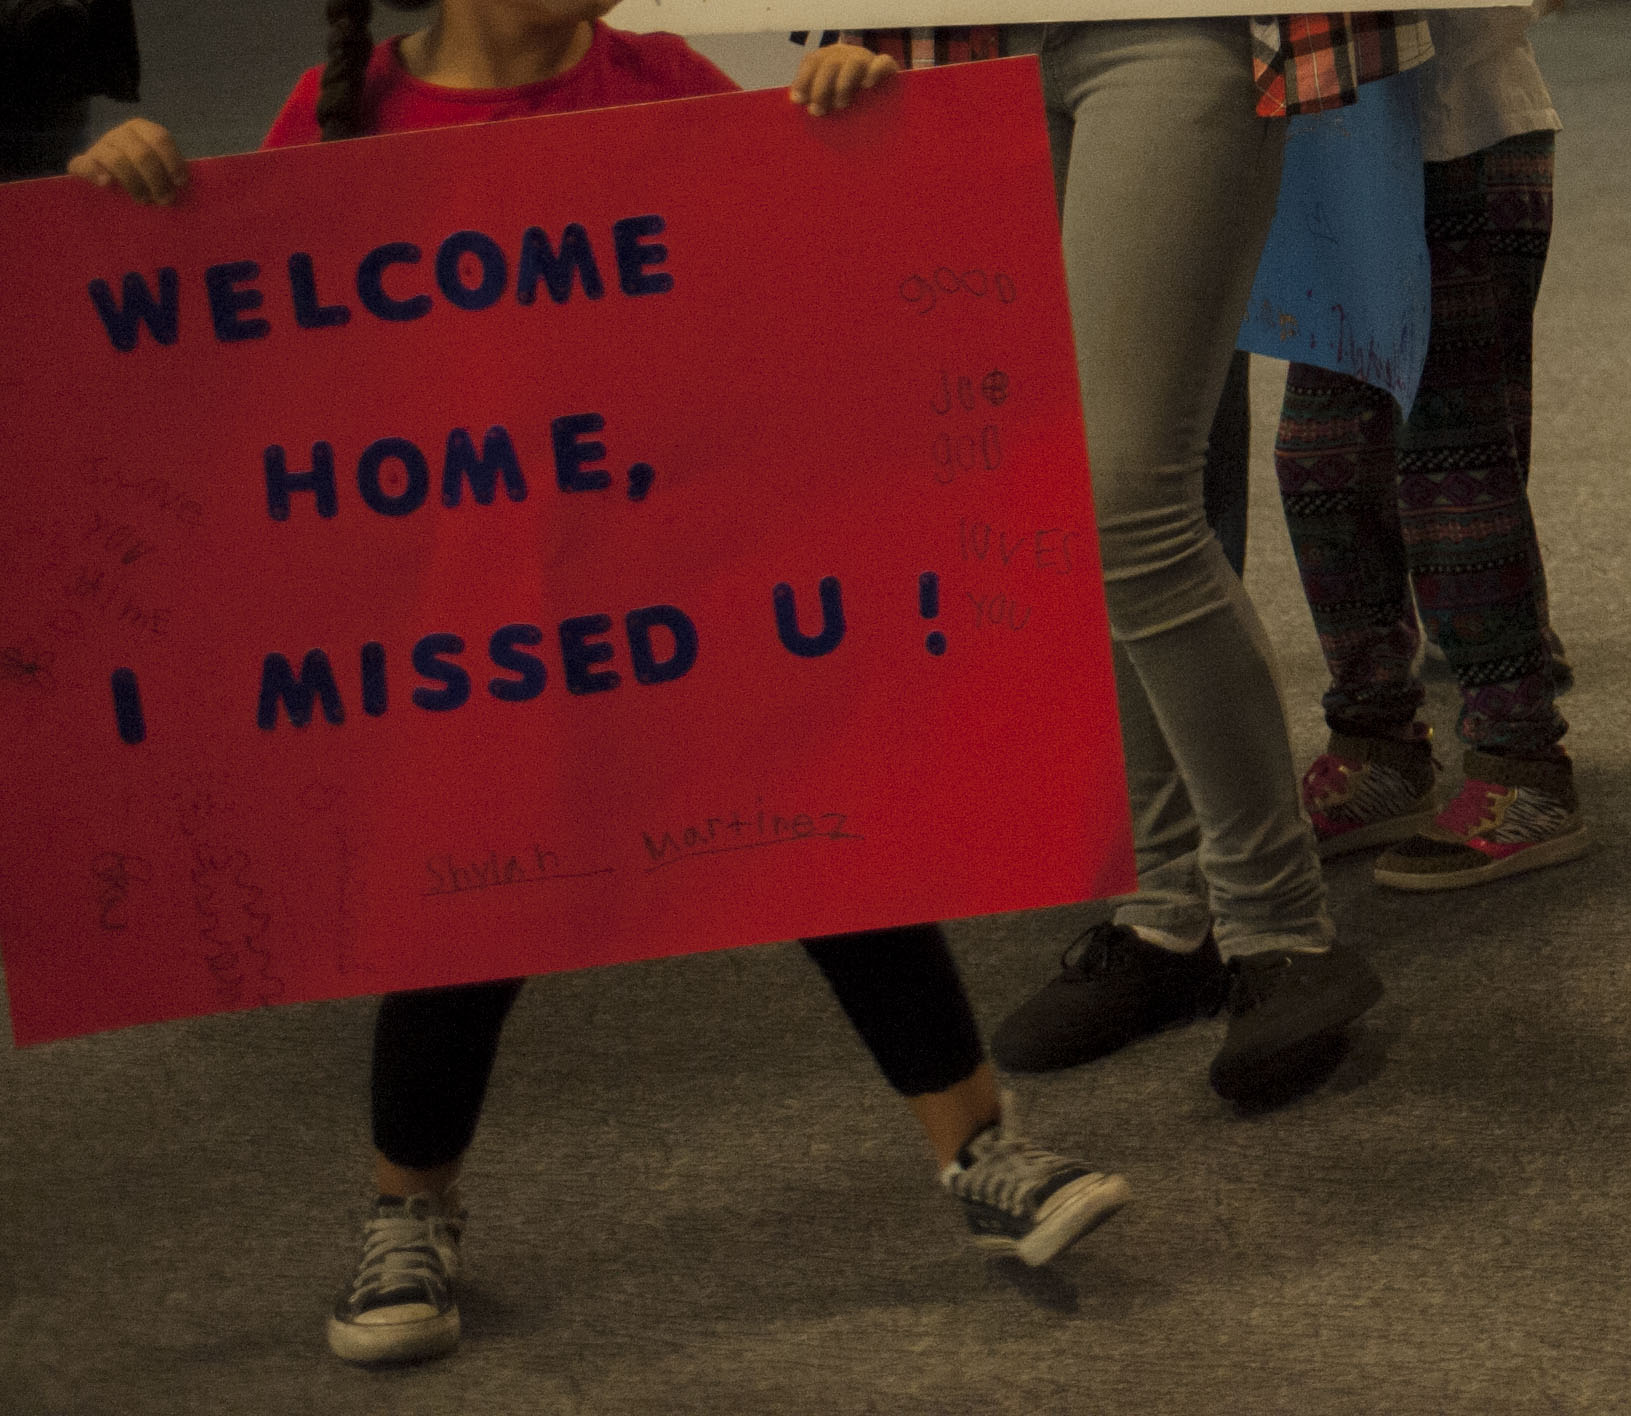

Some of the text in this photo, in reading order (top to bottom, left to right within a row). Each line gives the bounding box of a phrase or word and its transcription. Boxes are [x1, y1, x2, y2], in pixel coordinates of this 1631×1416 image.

[87, 213, 676, 353] WELCOME
[262, 413, 656, 523] HOME,
[110, 666, 147, 746] I
[257, 604, 699, 731] MISSED
[771, 575, 848, 659] U
